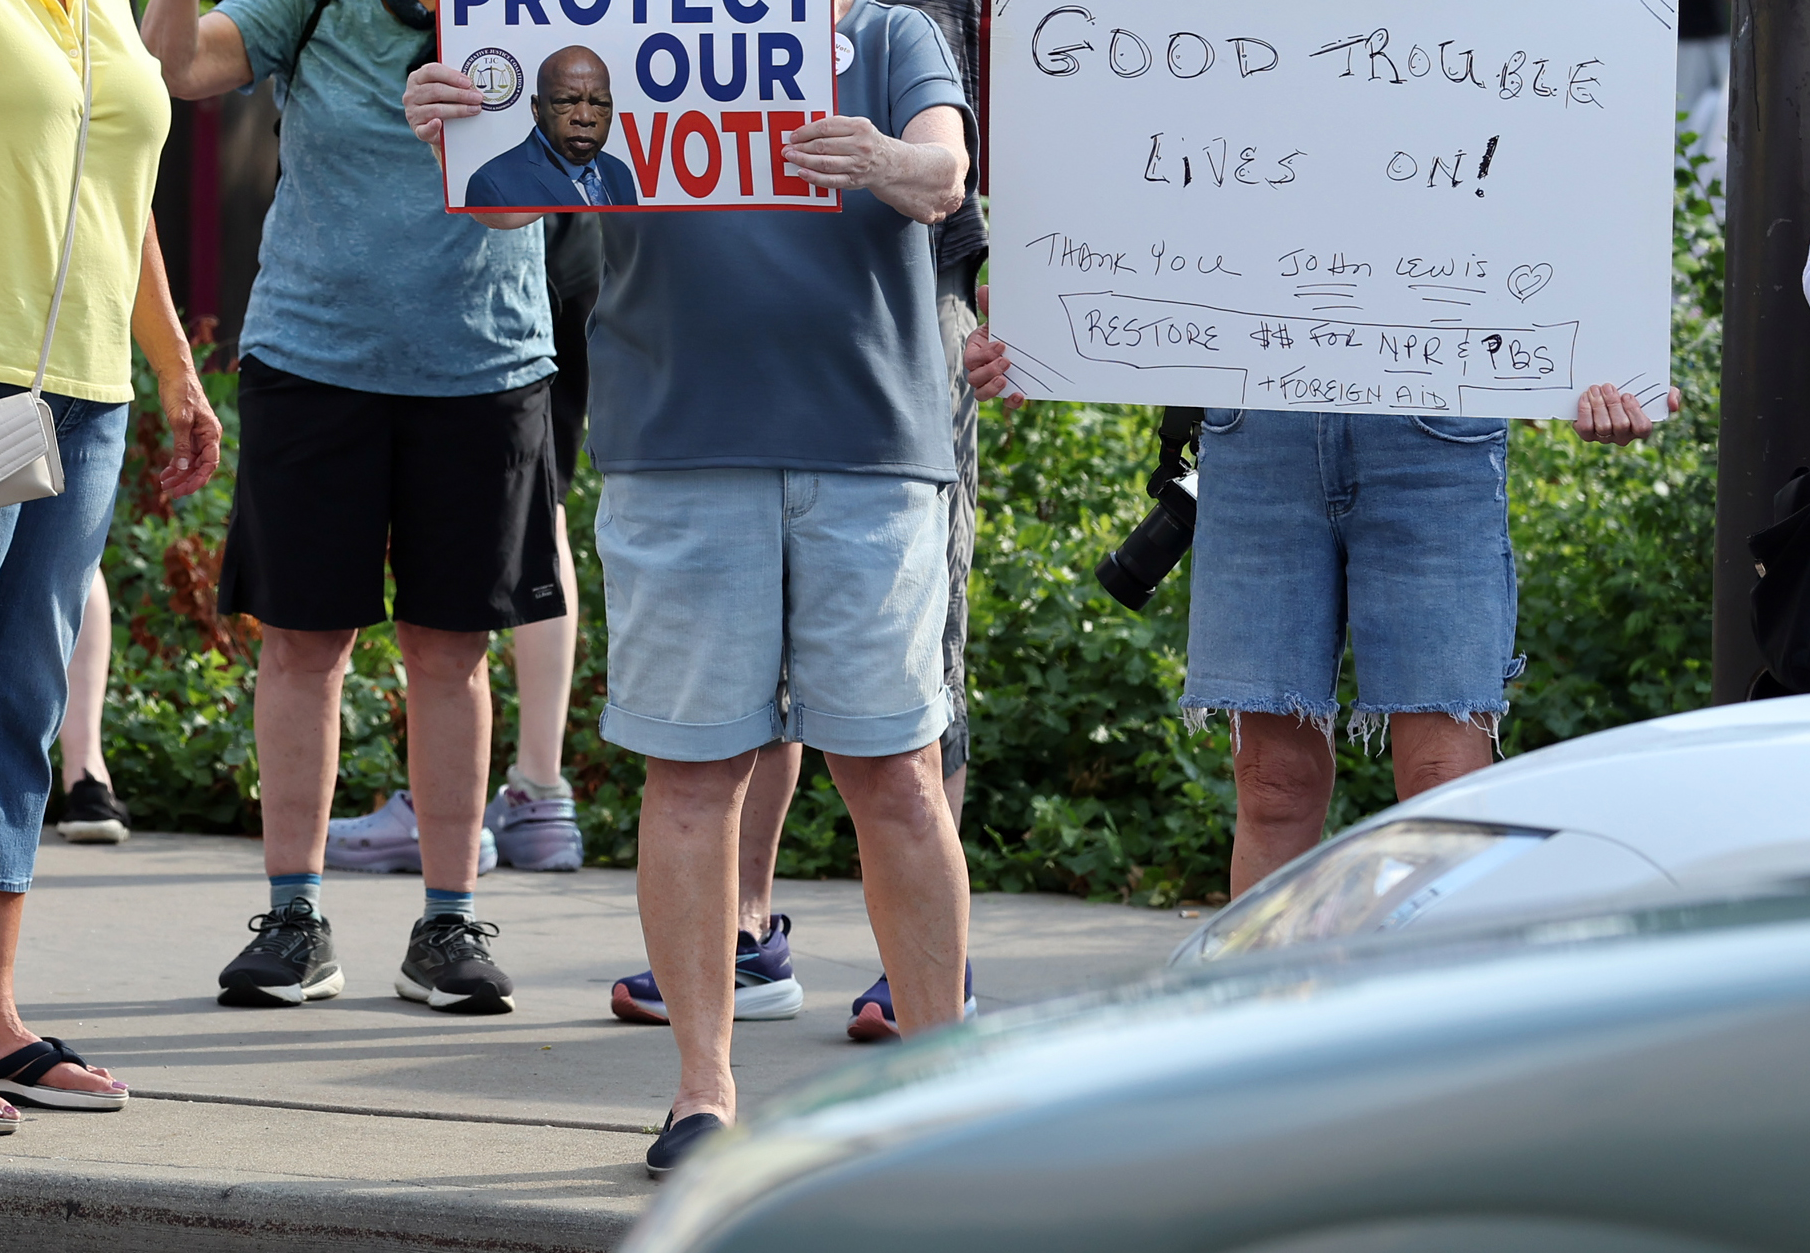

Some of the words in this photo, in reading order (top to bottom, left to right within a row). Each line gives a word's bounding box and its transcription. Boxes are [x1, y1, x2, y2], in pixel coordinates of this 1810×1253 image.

[635, 32, 806, 102] OUR
[1032, 5, 1278, 78] GOOD
[1309, 27, 1605, 109] TROUBLE
[1386, 134, 1500, 198] ON!
[1085, 309, 1219, 351] RESTORE
[1250, 321, 1293, 350] $$
[1379, 332, 1443, 365] NPR
[1481, 333, 1555, 375] PBS
